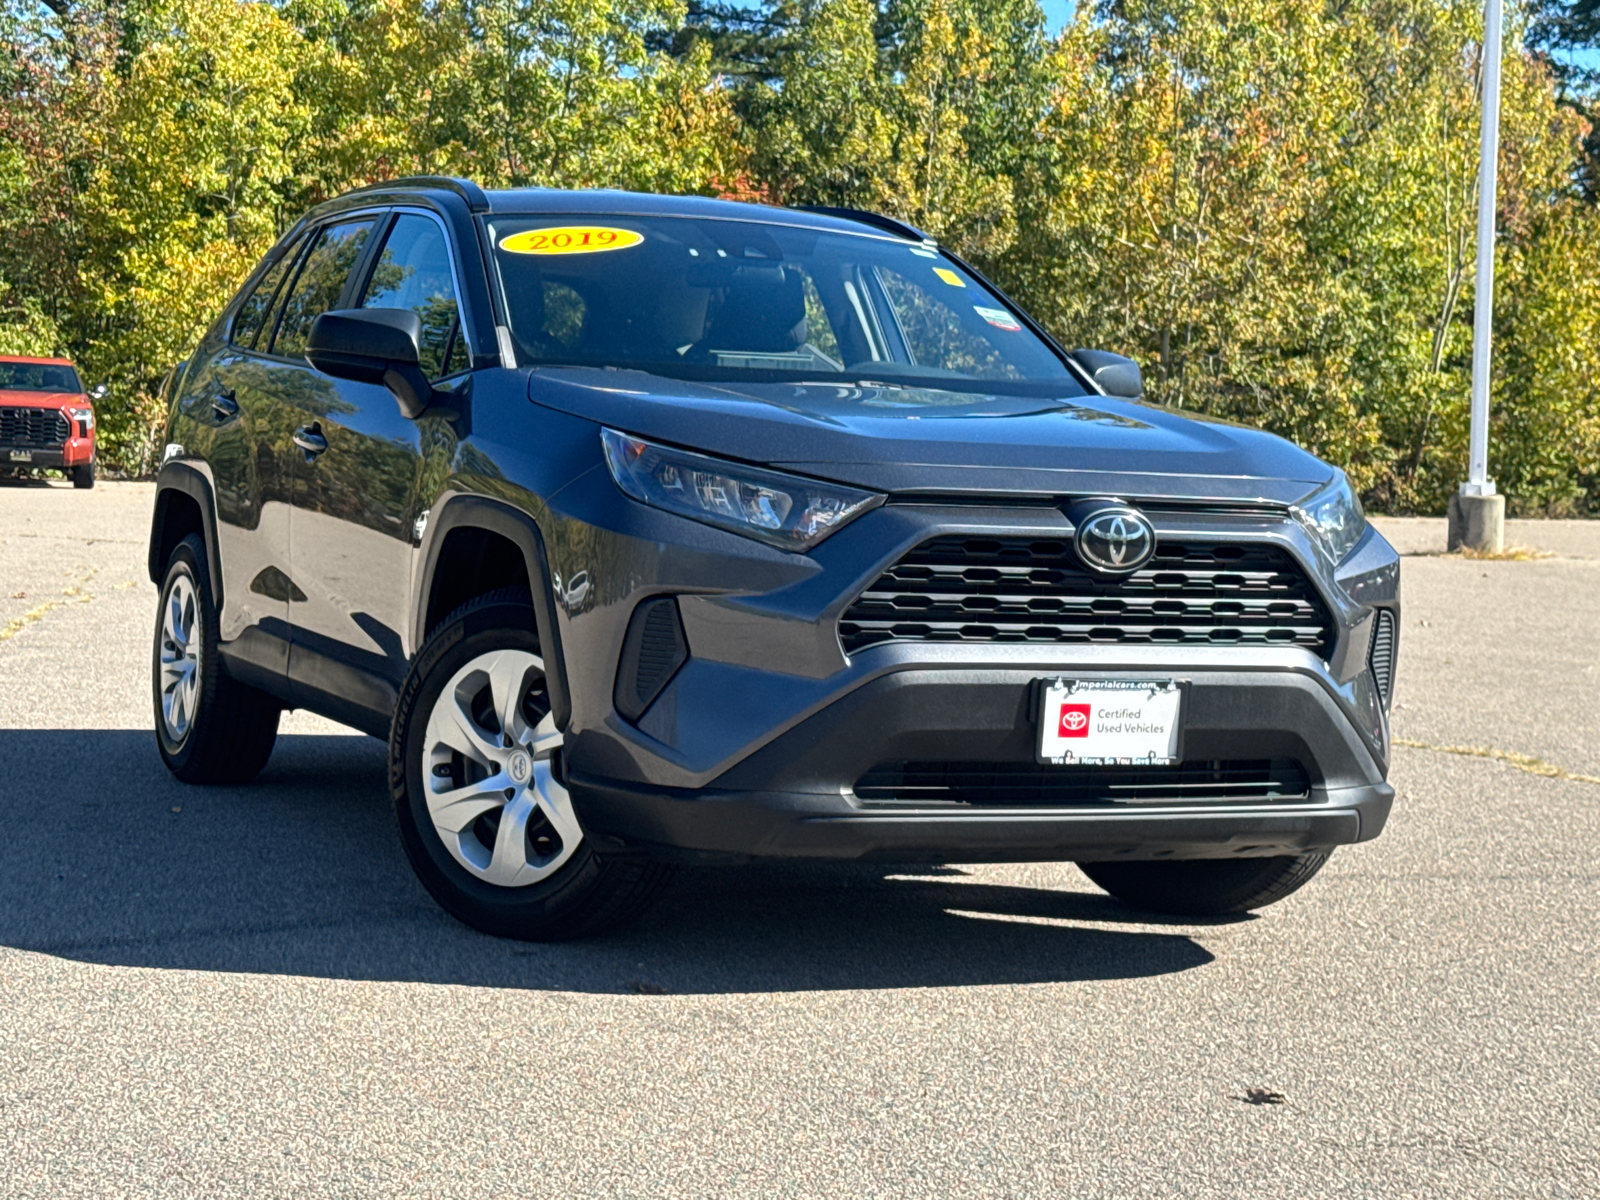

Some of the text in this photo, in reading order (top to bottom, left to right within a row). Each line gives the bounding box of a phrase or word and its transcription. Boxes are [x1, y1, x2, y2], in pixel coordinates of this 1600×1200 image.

[529, 231, 618, 250] 2019
[1075, 679, 1157, 690] Imperialcars.com
[393, 671, 420, 760] MICHELIN
[1098, 708, 1141, 719] Certified
[1097, 723, 1164, 734] Used Vehicles
[1051, 757, 1064, 765] We
[1104, 757, 1114, 765] So
[1116, 757, 1130, 765] You
[1131, 757, 1150, 765] Save
[1151, 757, 1170, 766] More
